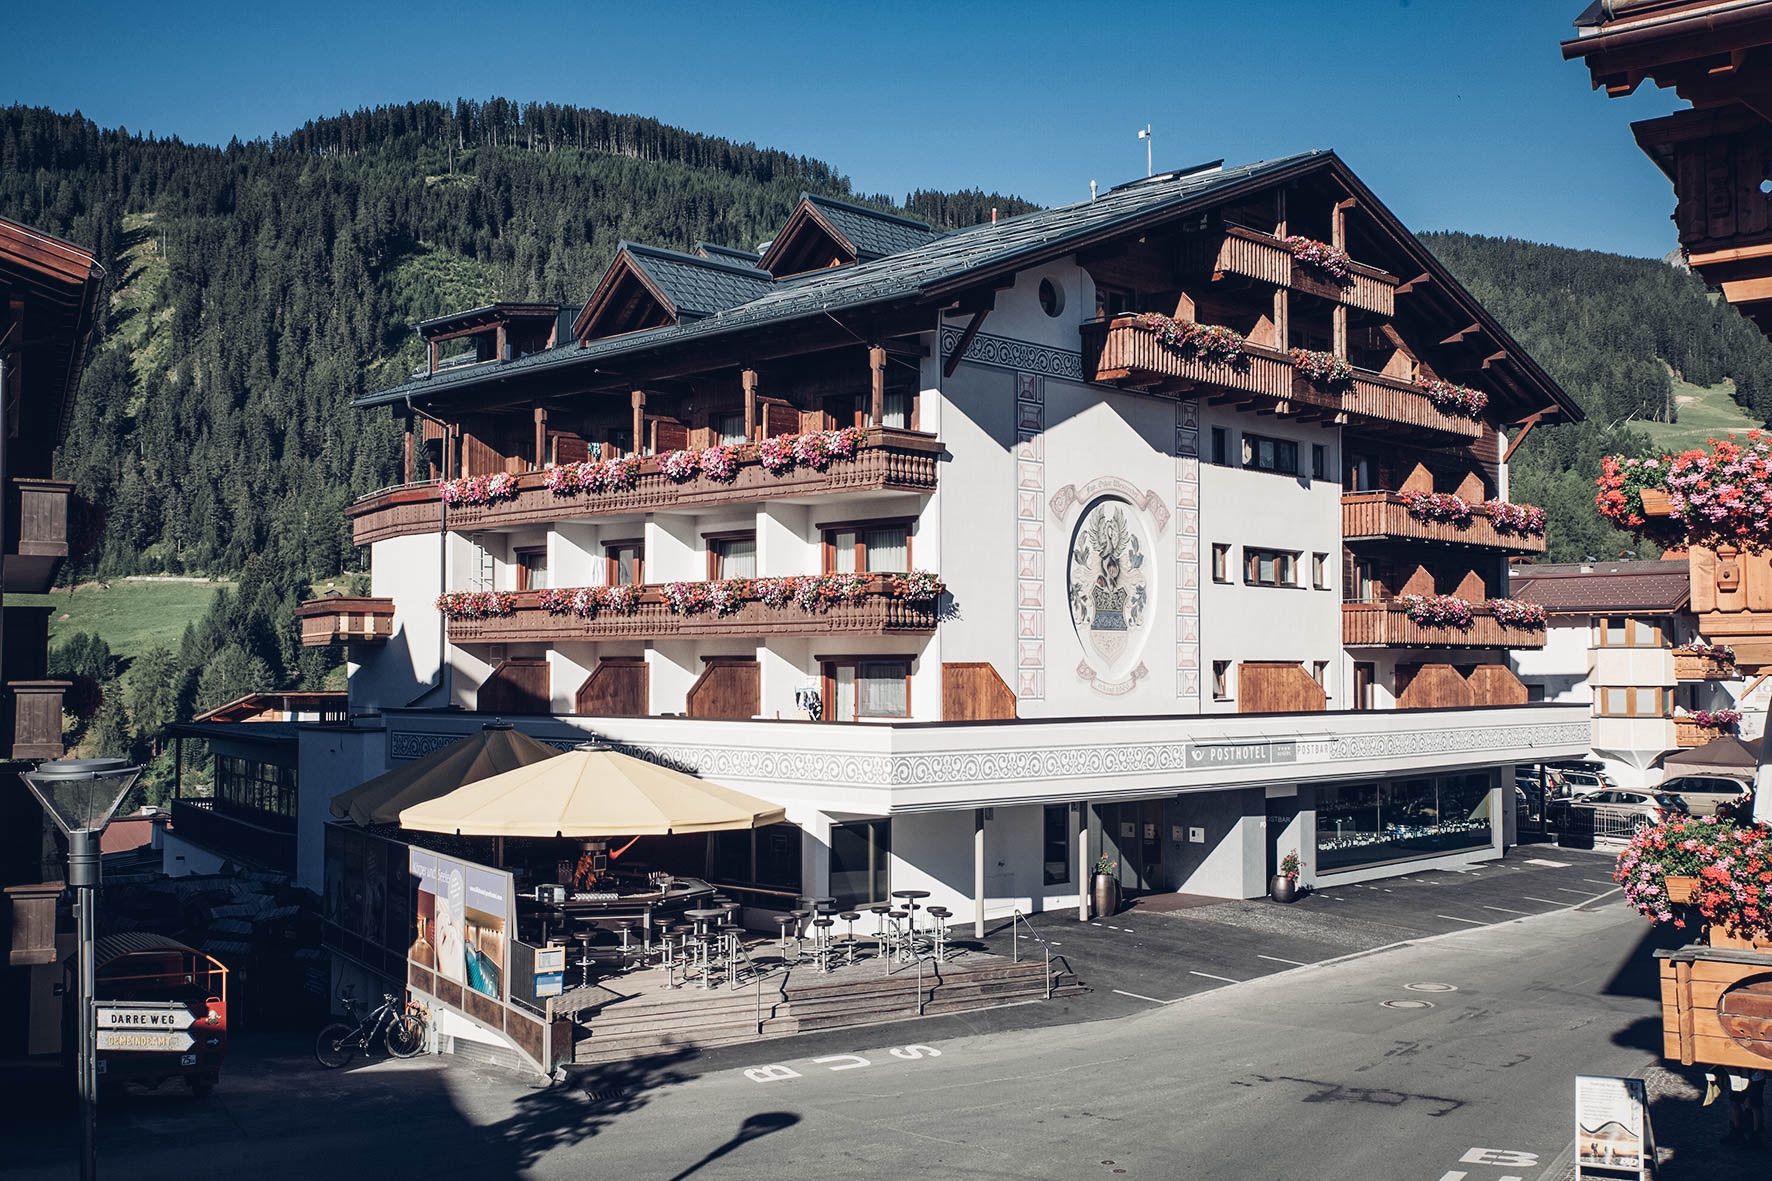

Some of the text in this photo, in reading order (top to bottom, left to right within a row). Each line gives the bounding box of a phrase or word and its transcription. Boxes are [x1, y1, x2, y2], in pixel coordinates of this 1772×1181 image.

[1210, 746, 1266, 761] POSTHOTEL
[1297, 743, 1328, 755] POSTBAR
[111, 1014, 175, 1025] DARRE WEG
[743, 1044, 942, 1083] BUS
